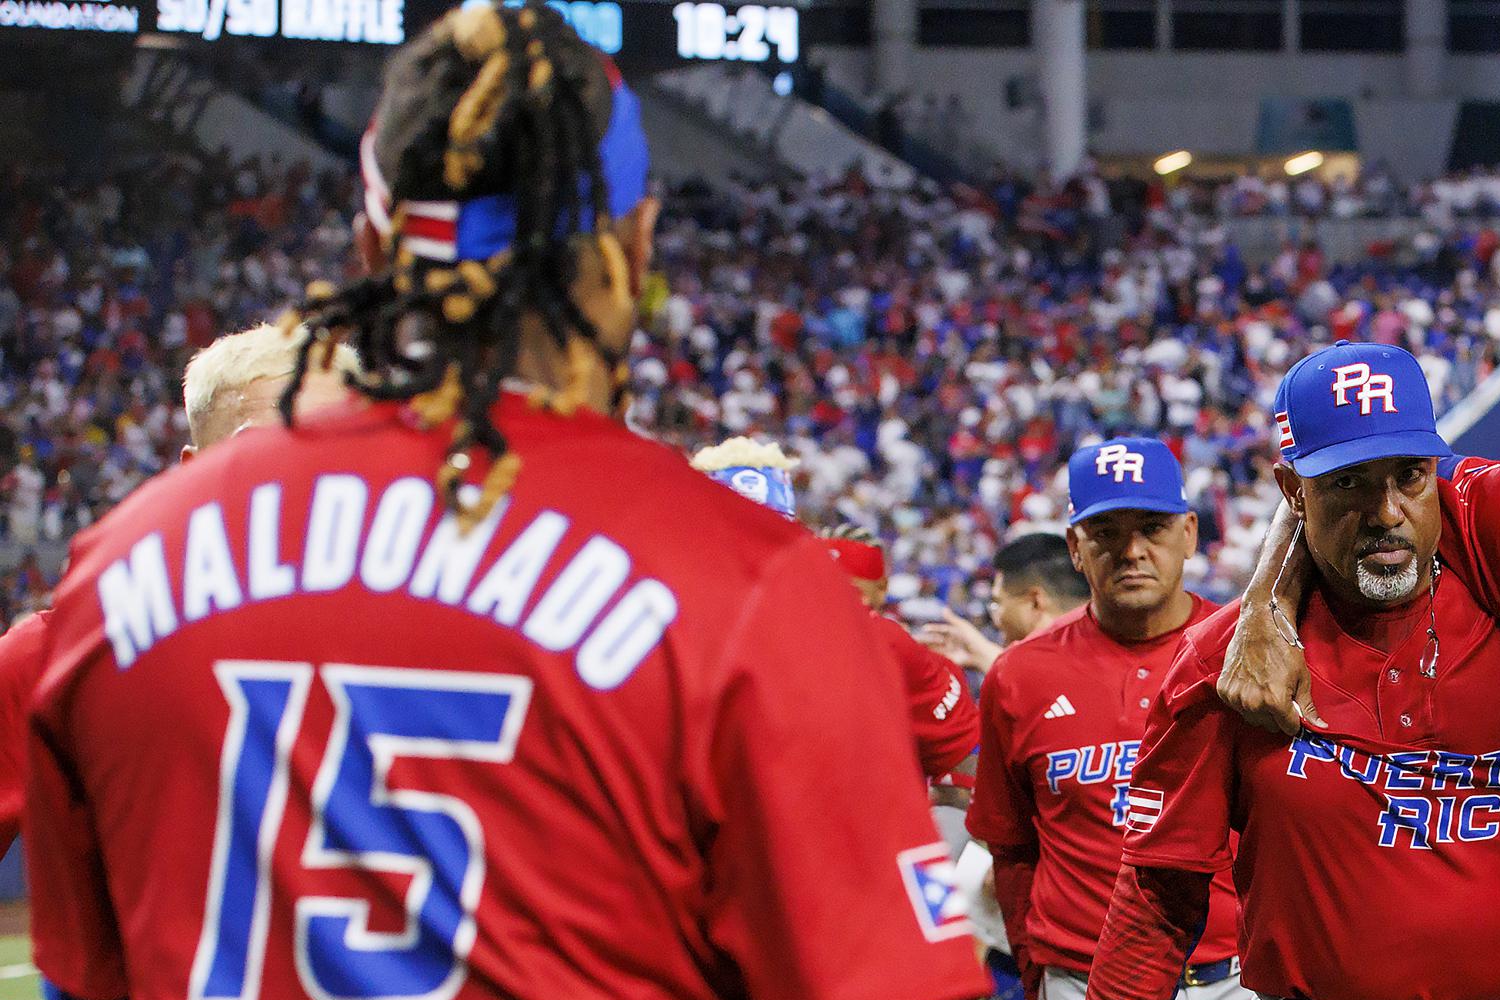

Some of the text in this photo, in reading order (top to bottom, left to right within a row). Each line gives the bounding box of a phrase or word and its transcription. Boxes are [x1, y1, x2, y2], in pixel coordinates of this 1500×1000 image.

[1330, 362, 1399, 416] PR
[1096, 444, 1145, 483] PR
[98, 474, 679, 691] MALDONADO
